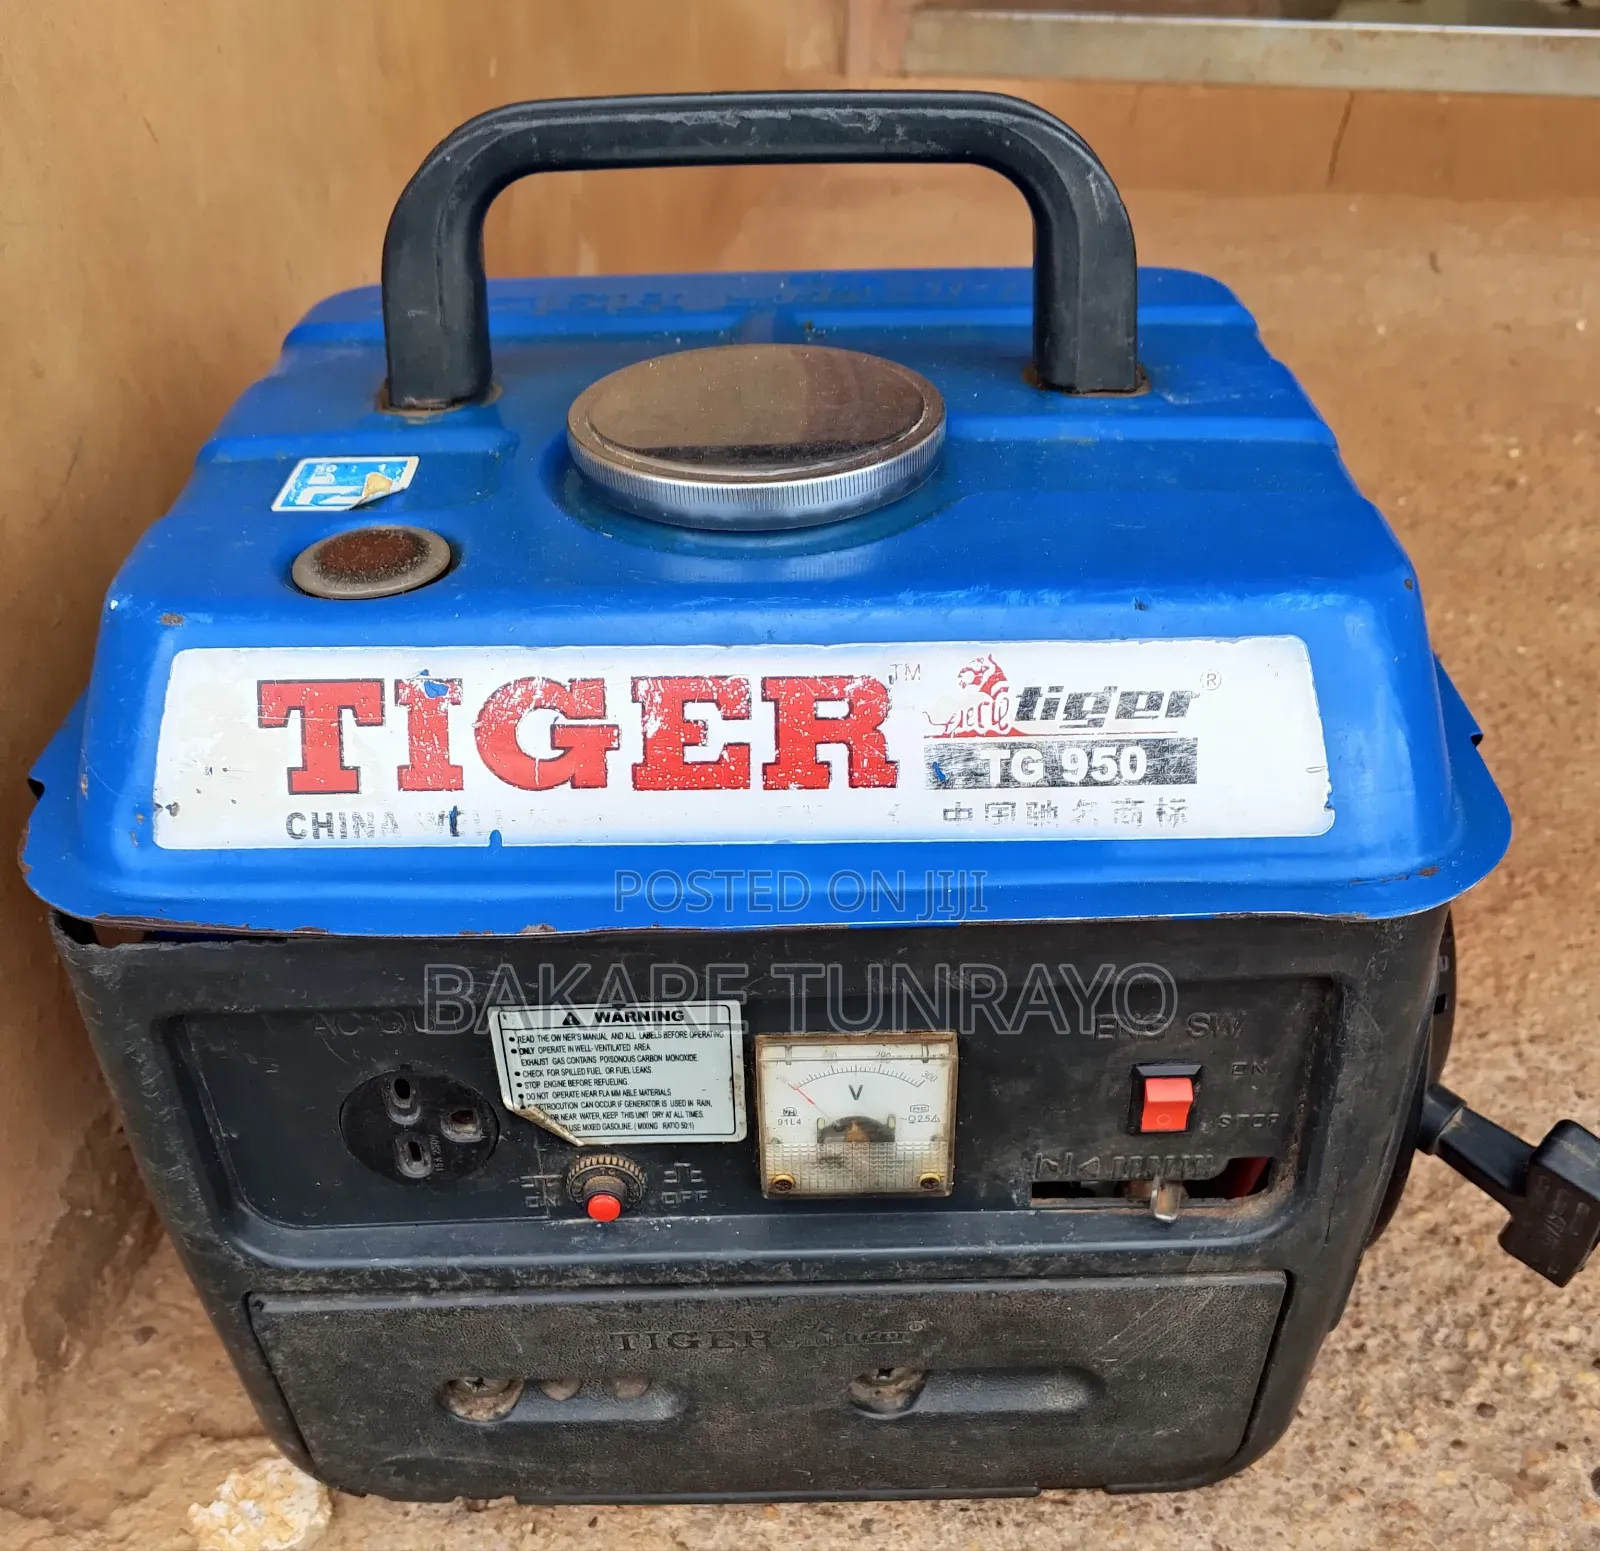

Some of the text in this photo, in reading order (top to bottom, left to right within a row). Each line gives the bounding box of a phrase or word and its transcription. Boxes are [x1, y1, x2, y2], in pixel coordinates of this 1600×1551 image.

[257, 674, 900, 794] TIGER
[1014, 685, 1200, 729] tiger
[980, 747, 1147, 784] TG 950
[286, 811, 403, 839] CHINA
[594, 1010, 685, 1023] WARNING
[1186, 1011, 1247, 1038] SW
[517, 1035, 535, 1044] READ
[538, 1034, 550, 1042] THE
[582, 1033, 608, 1041] MANUAL
[611, 1032, 624, 1040] AND
[625, 1031, 636, 1040] ALL
[639, 1031, 662, 1040] LABELS
[663, 1030, 688, 1039] BEFORE
[689, 1030, 724, 1038] OPERATING
[519, 1046, 535, 1055] ONLY
[538, 1045, 566, 1054] OPERATE
[568, 1045, 574, 1053] IN
[521, 1057, 549, 1067] EXHAUST
[552, 1057, 566, 1065] GAS
[567, 1056, 597, 1065] CONTAINS
[599, 1055, 636, 1064] POISONOUS
[637, 1054, 663, 1063] CARBON
[522, 1069, 544, 1078] CHECK
[547, 1068, 560, 1077] FOR
[561, 1067, 585, 1077] SPILLED
[587, 1067, 602, 1075] FUEL
[605, 1067, 615, 1075] OR
[616, 1066, 631, 1074] FUEL
[921, 1070, 938, 1082] 300
[524, 1081, 540, 1089] STOP
[544, 1079, 566, 1088] ENGINE
[568, 1078, 592, 1087] BEFORE
[526, 1092, 535, 1100] DO
[536, 1092, 549, 1100] NOT
[552, 1090, 580, 1099] OPERATE
[581, 1090, 598, 1098] NEAR
[639, 1088, 671, 1097] MATERIALS
[848, 1084, 863, 1101] V
[581, 1101, 594, 1109] CAN
[595, 1100, 617, 1109] OCCUR
[624, 1099, 660, 1108] GENERATOR
[670, 1099, 686, 1107] USED
[561, 1112, 577, 1121] NEAR
[603, 1111, 618, 1120] KEEP
[621, 1111, 634, 1119] THIS
[635, 1111, 649, 1119] UNIT
[652, 1110, 664, 1119] DRY
[665, 1110, 672, 1118] AT
[674, 1110, 684, 1118] ALL
[569, 1124, 581, 1132] USE
[582, 1122, 601, 1131] MIXED
[662, 1121, 680, 1130] RATIO
[662, 1190, 708, 1204] OFF
[612, 1331, 771, 1351] TIGER
